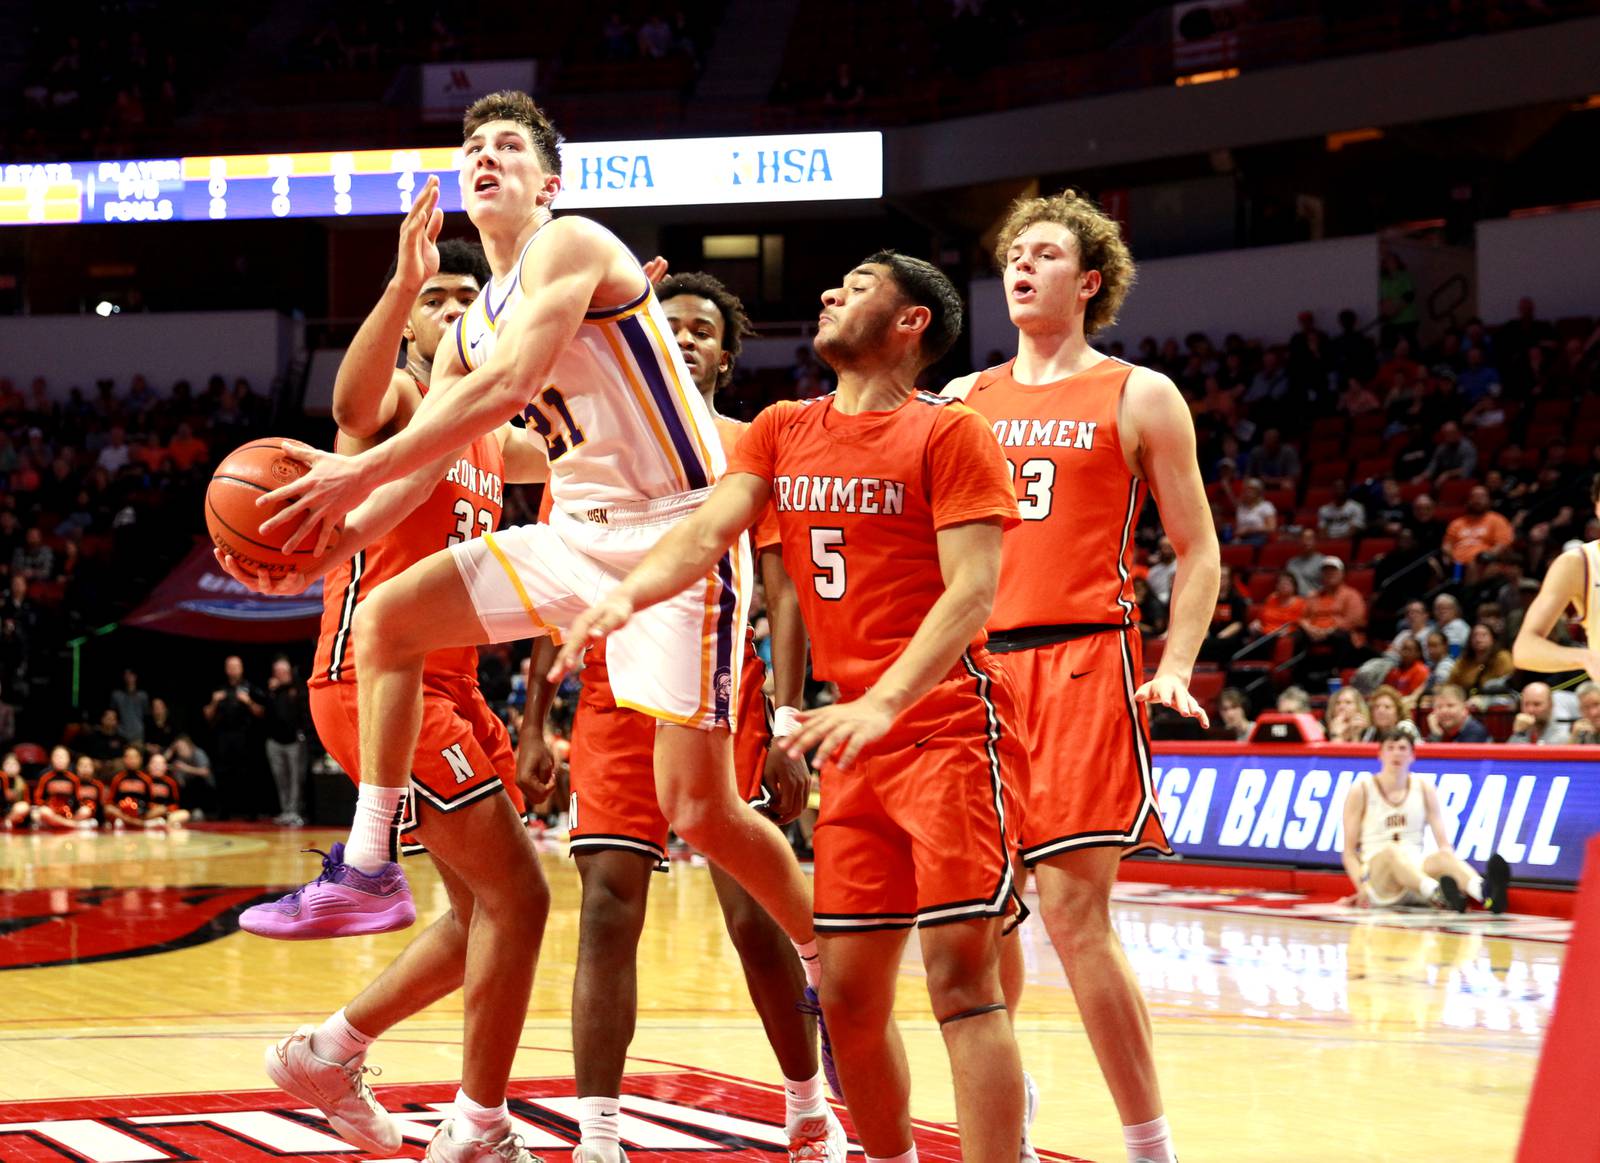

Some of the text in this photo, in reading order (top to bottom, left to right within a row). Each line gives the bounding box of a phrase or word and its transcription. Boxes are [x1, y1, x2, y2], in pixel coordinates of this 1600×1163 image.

[562, 155, 655, 191] HSA
[992, 419, 1097, 451] ONMEN
[446, 459, 503, 508] RONME
[1006, 458, 1056, 521] 3
[810, 527, 847, 600] 5
[441, 743, 475, 784] N
[1218, 768, 1571, 866] BASKBALL
